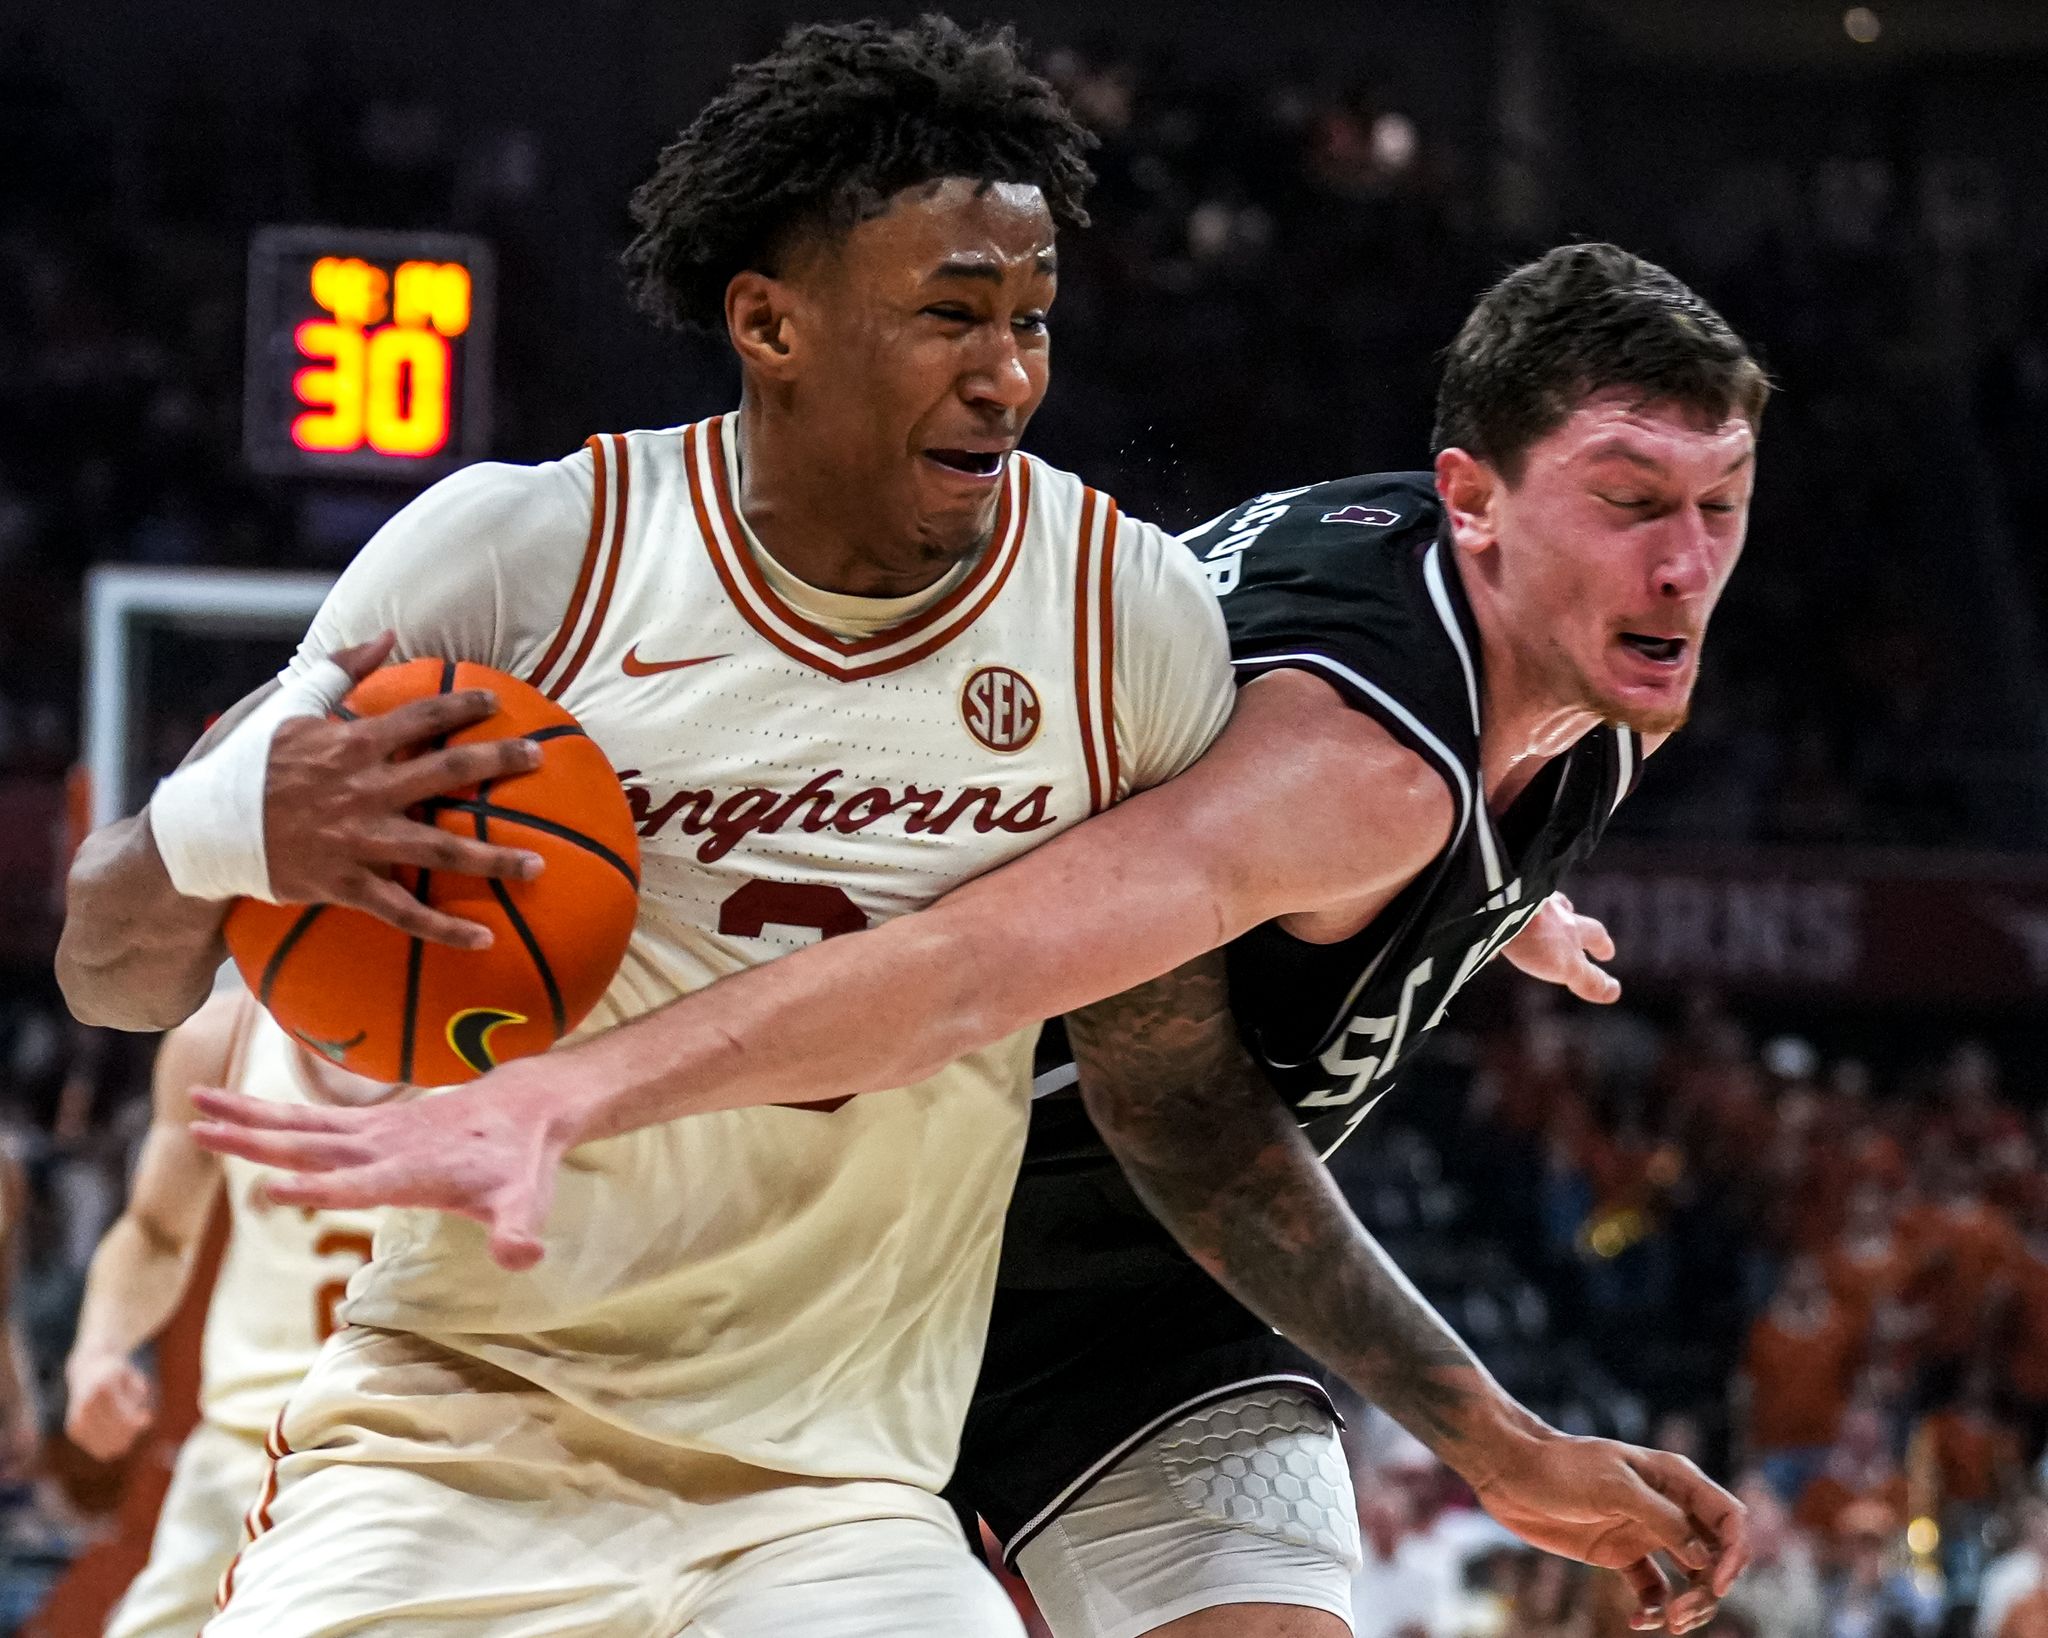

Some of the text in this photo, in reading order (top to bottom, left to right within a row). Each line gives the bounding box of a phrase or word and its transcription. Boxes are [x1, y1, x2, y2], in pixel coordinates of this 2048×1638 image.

[291, 319, 450, 458] 30
[967, 671, 1035, 745] SEC
[617, 768, 1058, 864] onghorns
